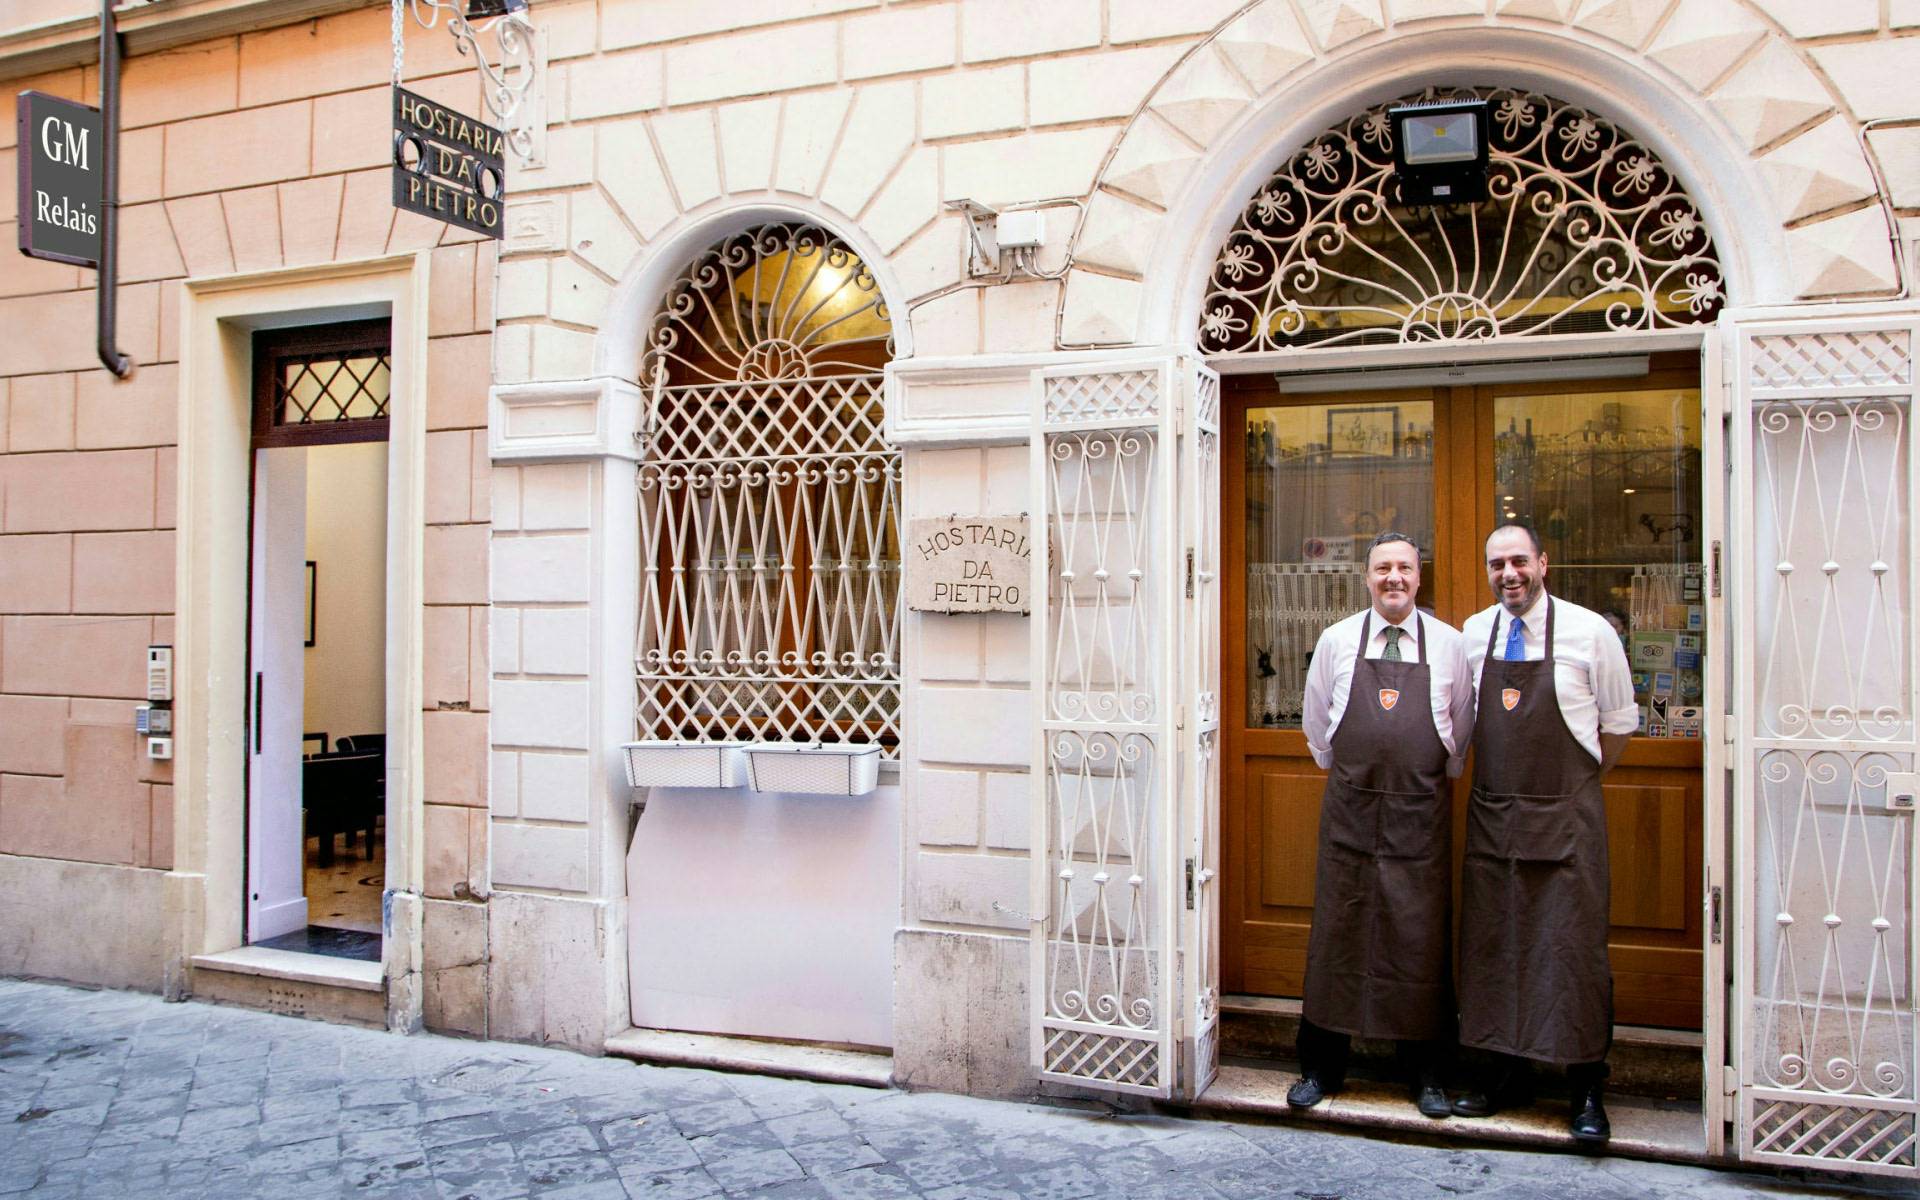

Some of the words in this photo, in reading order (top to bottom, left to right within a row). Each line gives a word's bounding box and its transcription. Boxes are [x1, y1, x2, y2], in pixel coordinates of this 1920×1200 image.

[41, 116, 90, 171] GM
[402, 95, 504, 156] HOSTARIA
[440, 150, 472, 182] DA
[36, 190, 97, 235] Relais
[410, 177, 498, 227] PIETRO
[963, 560, 994, 580] DA
[934, 583, 1020, 605] PIETRO
